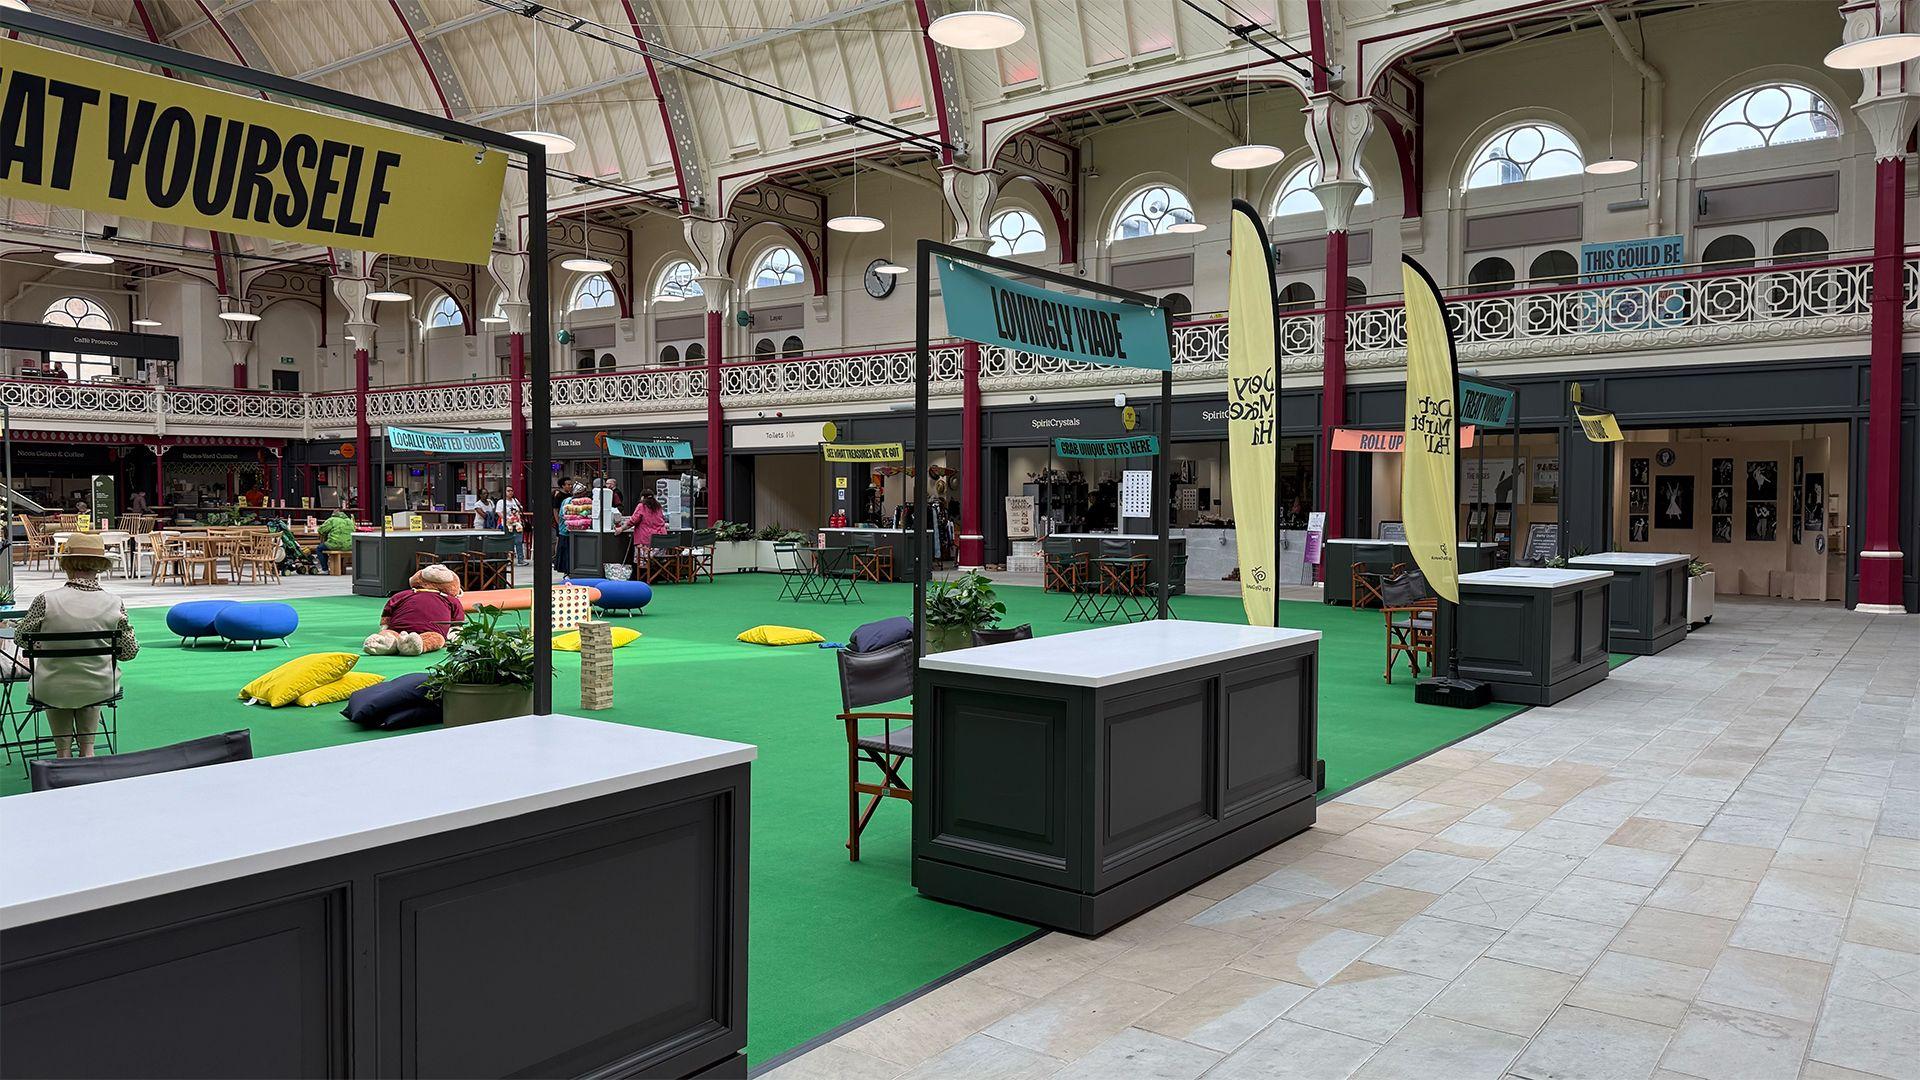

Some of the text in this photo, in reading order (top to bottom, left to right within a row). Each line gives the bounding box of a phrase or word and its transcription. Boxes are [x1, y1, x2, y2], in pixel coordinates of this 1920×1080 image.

[0, 68, 401, 239] AT YOURSELF
[1584, 243, 1681, 271] THIS COULD BE
[990, 286, 1127, 359] LOVINGLY MADE
[1460, 389, 1486, 420] TREAT
[1031, 418, 1080, 428] SpiritCrystals
[393, 431, 501, 450] LOCALLY CRAFTED GOODIES
[1061, 439, 1152, 457] GRAB UNIQUE GIFTS HERE
[1360, 434, 1403, 450] ROLL UP
[621, 443, 675, 458] ROLL UP ROLL UP
[826, 448, 834, 458] SEE
[845, 449, 872, 459] TREASURES
[889, 447, 900, 457] GOT
